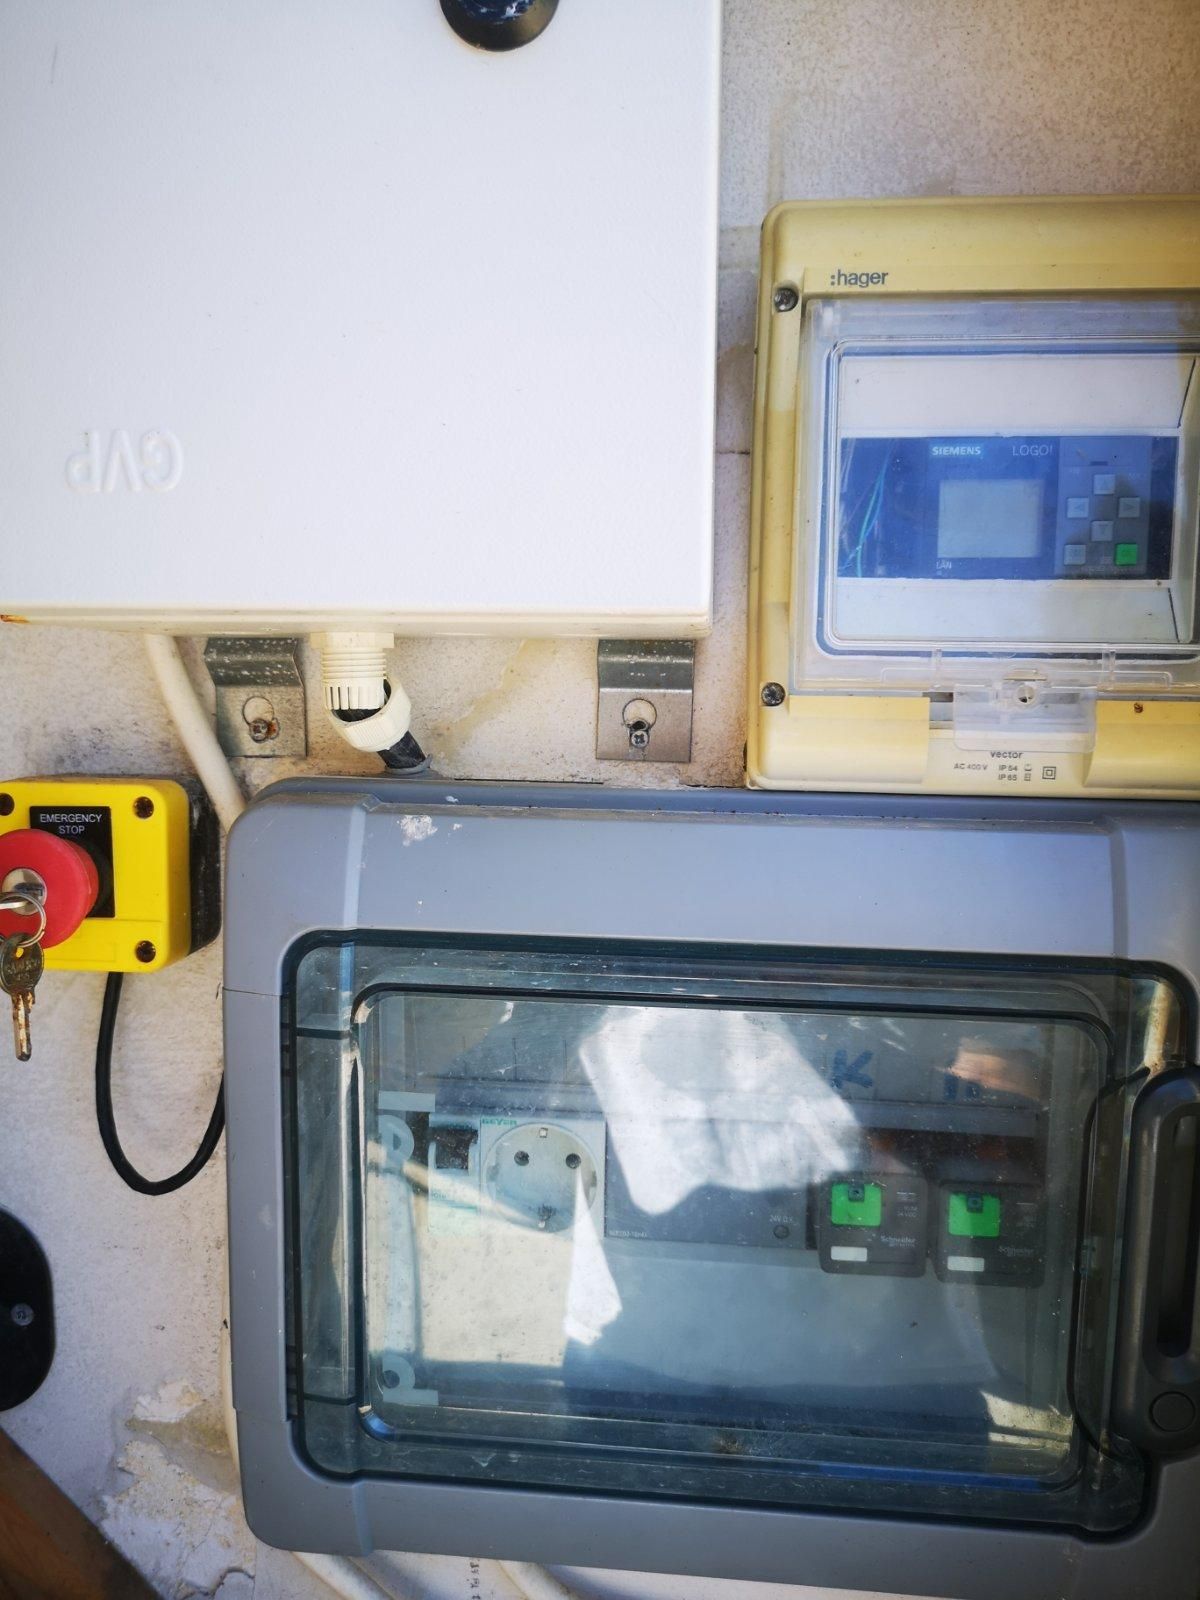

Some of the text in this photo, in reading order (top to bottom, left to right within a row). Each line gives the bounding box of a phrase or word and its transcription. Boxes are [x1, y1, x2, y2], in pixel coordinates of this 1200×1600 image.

[931, 446, 982, 456] SIEMENS
[1012, 445, 1054, 456] LOGO!
[63, 428, 184, 495] GVP
[990, 751, 1024, 759] vector
[39, 813, 103, 823] EMERGENCY
[58, 824, 86, 835] STOP
